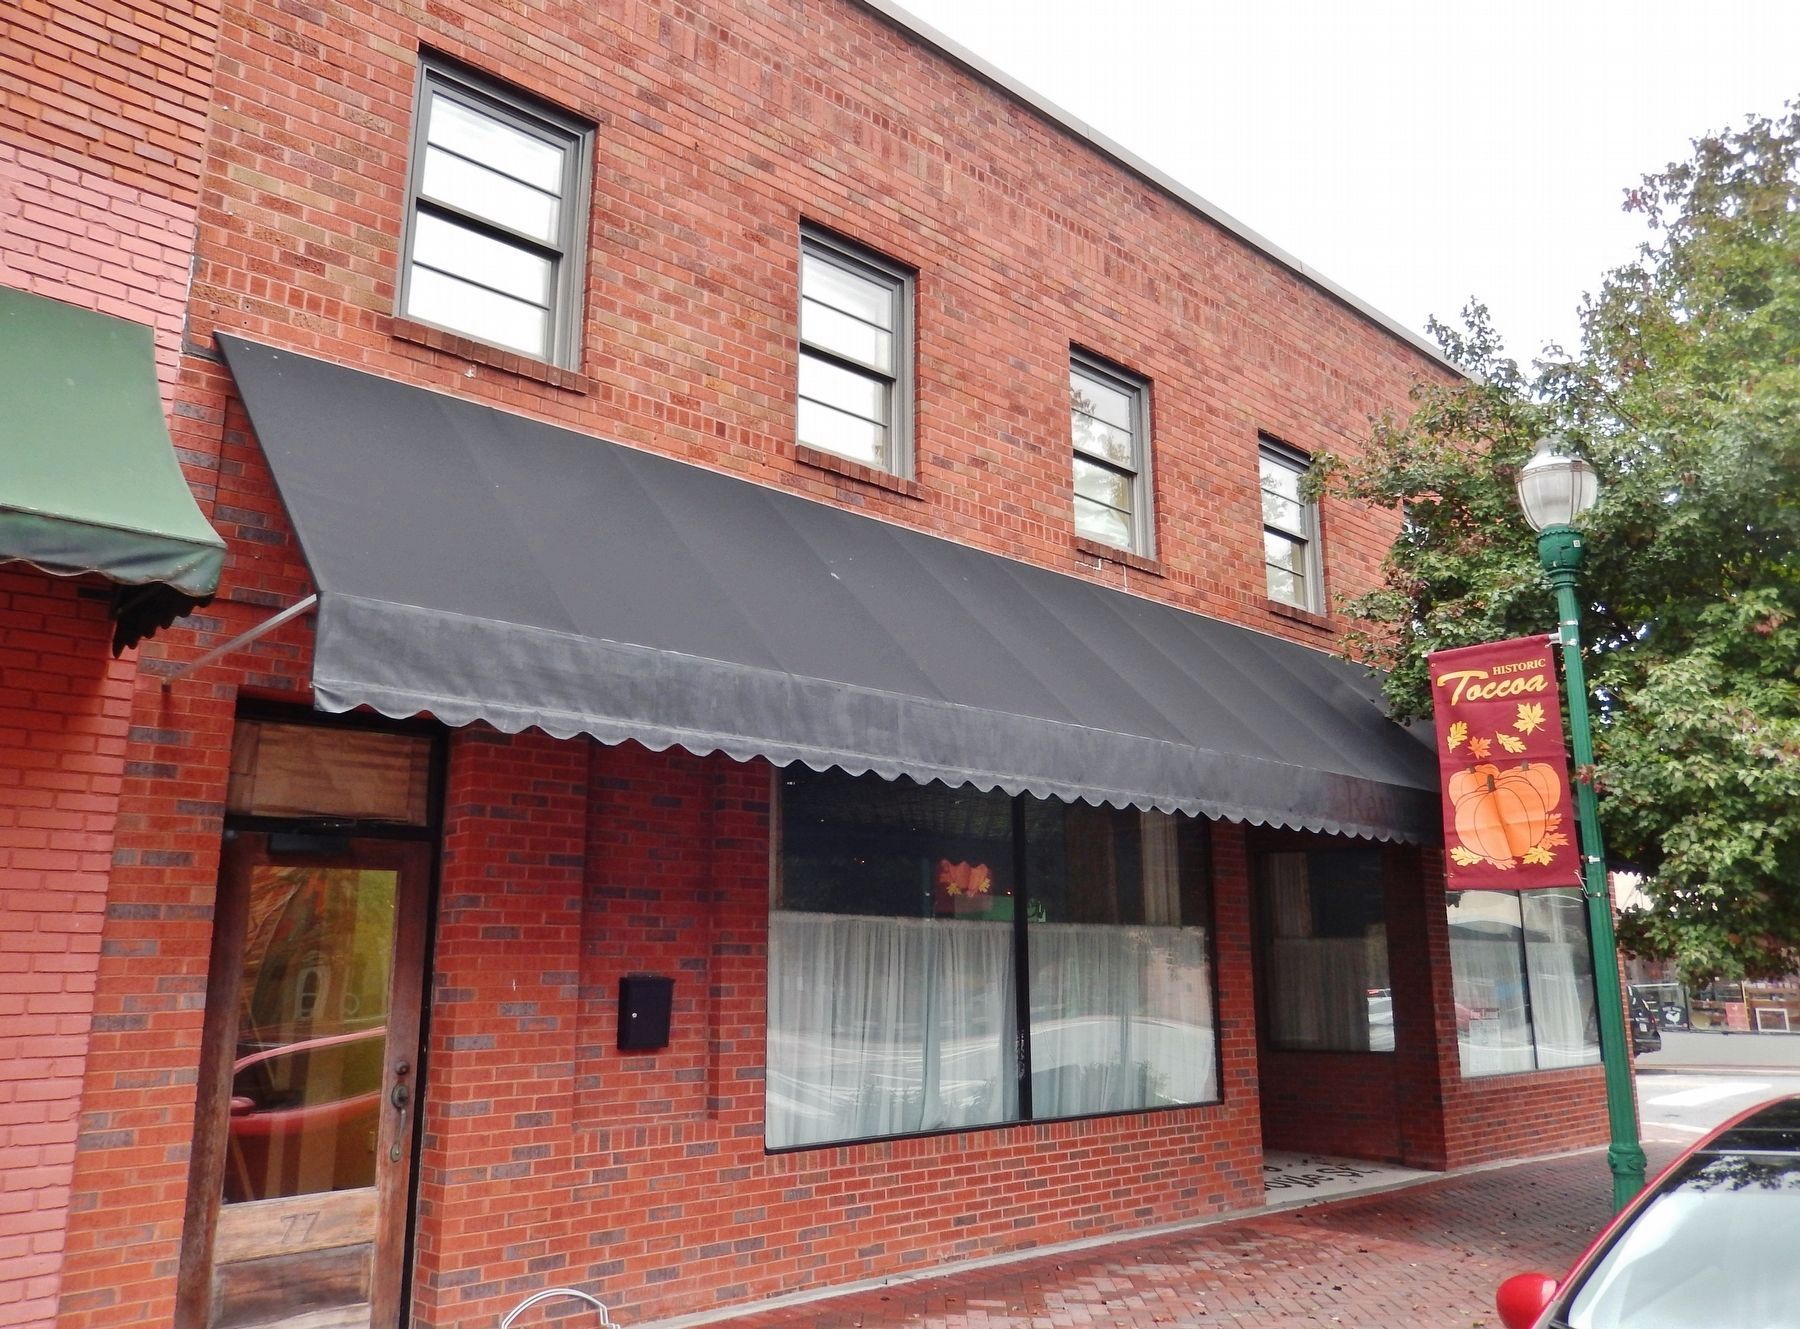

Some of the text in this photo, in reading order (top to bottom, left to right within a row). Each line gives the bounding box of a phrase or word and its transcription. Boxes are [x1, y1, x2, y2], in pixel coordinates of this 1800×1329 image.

[1492, 658, 1546, 676] HISTORIC
[1437, 670, 1548, 706] Toccoa
[280, 1210, 320, 1245] 77
